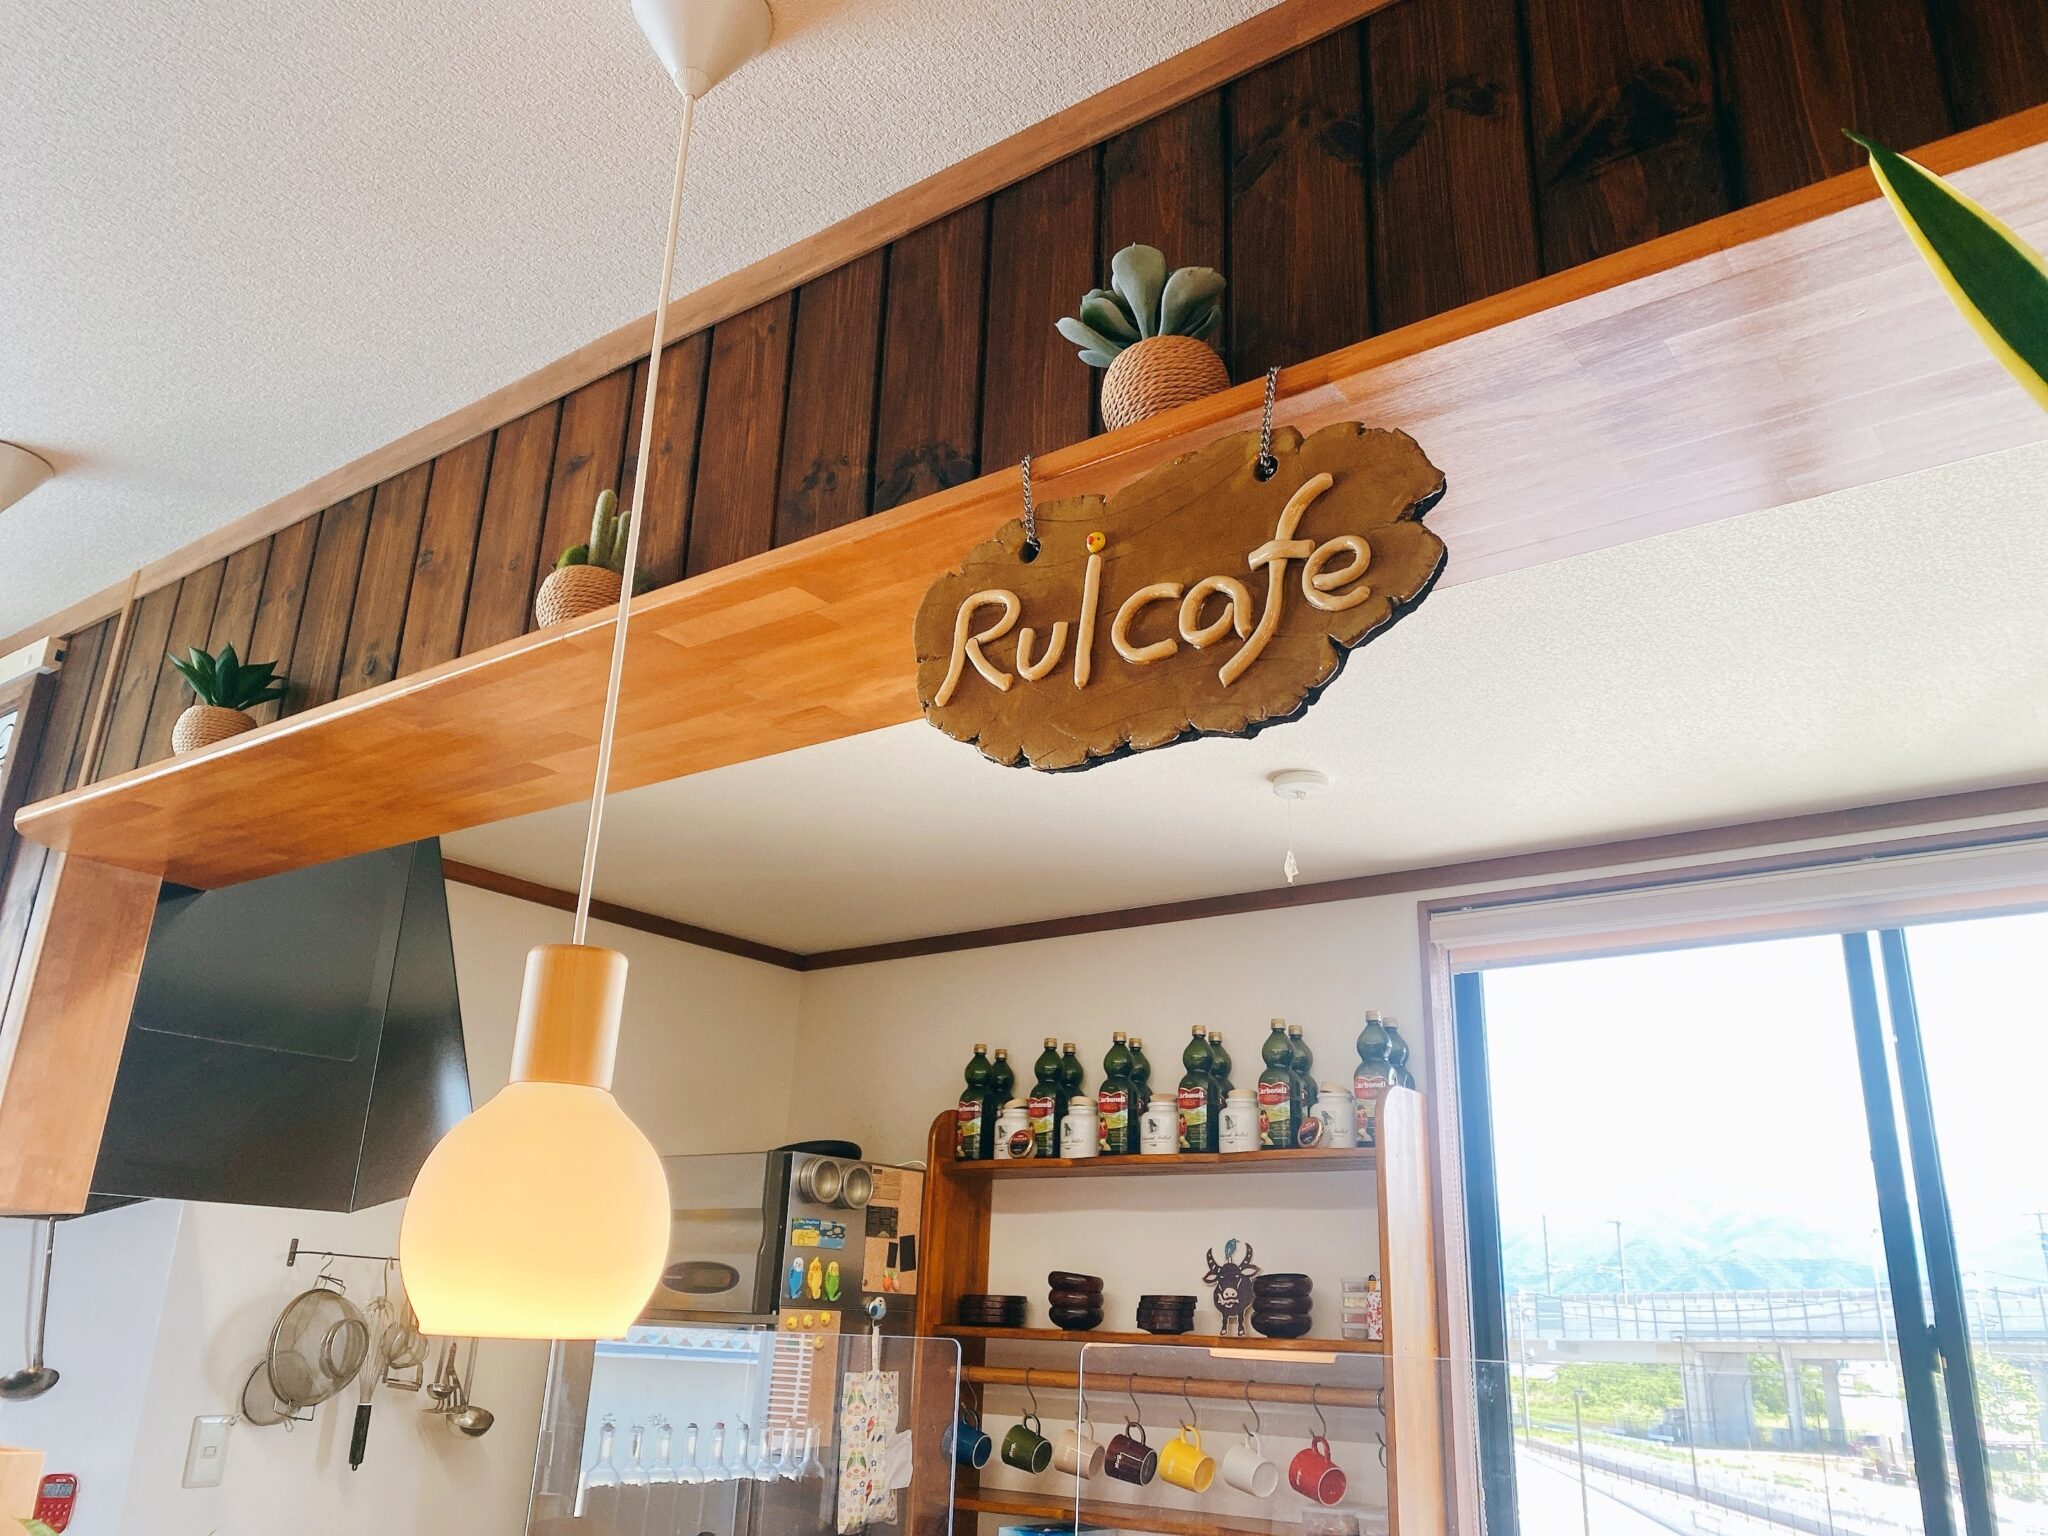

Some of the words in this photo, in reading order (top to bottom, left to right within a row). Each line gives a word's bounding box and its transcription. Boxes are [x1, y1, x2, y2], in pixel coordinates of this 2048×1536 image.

[1100, 1095, 1126, 1103] arbonell
[1180, 1091, 1204, 1099] arbonell
[1029, 1100, 1052, 1108] arbonell
